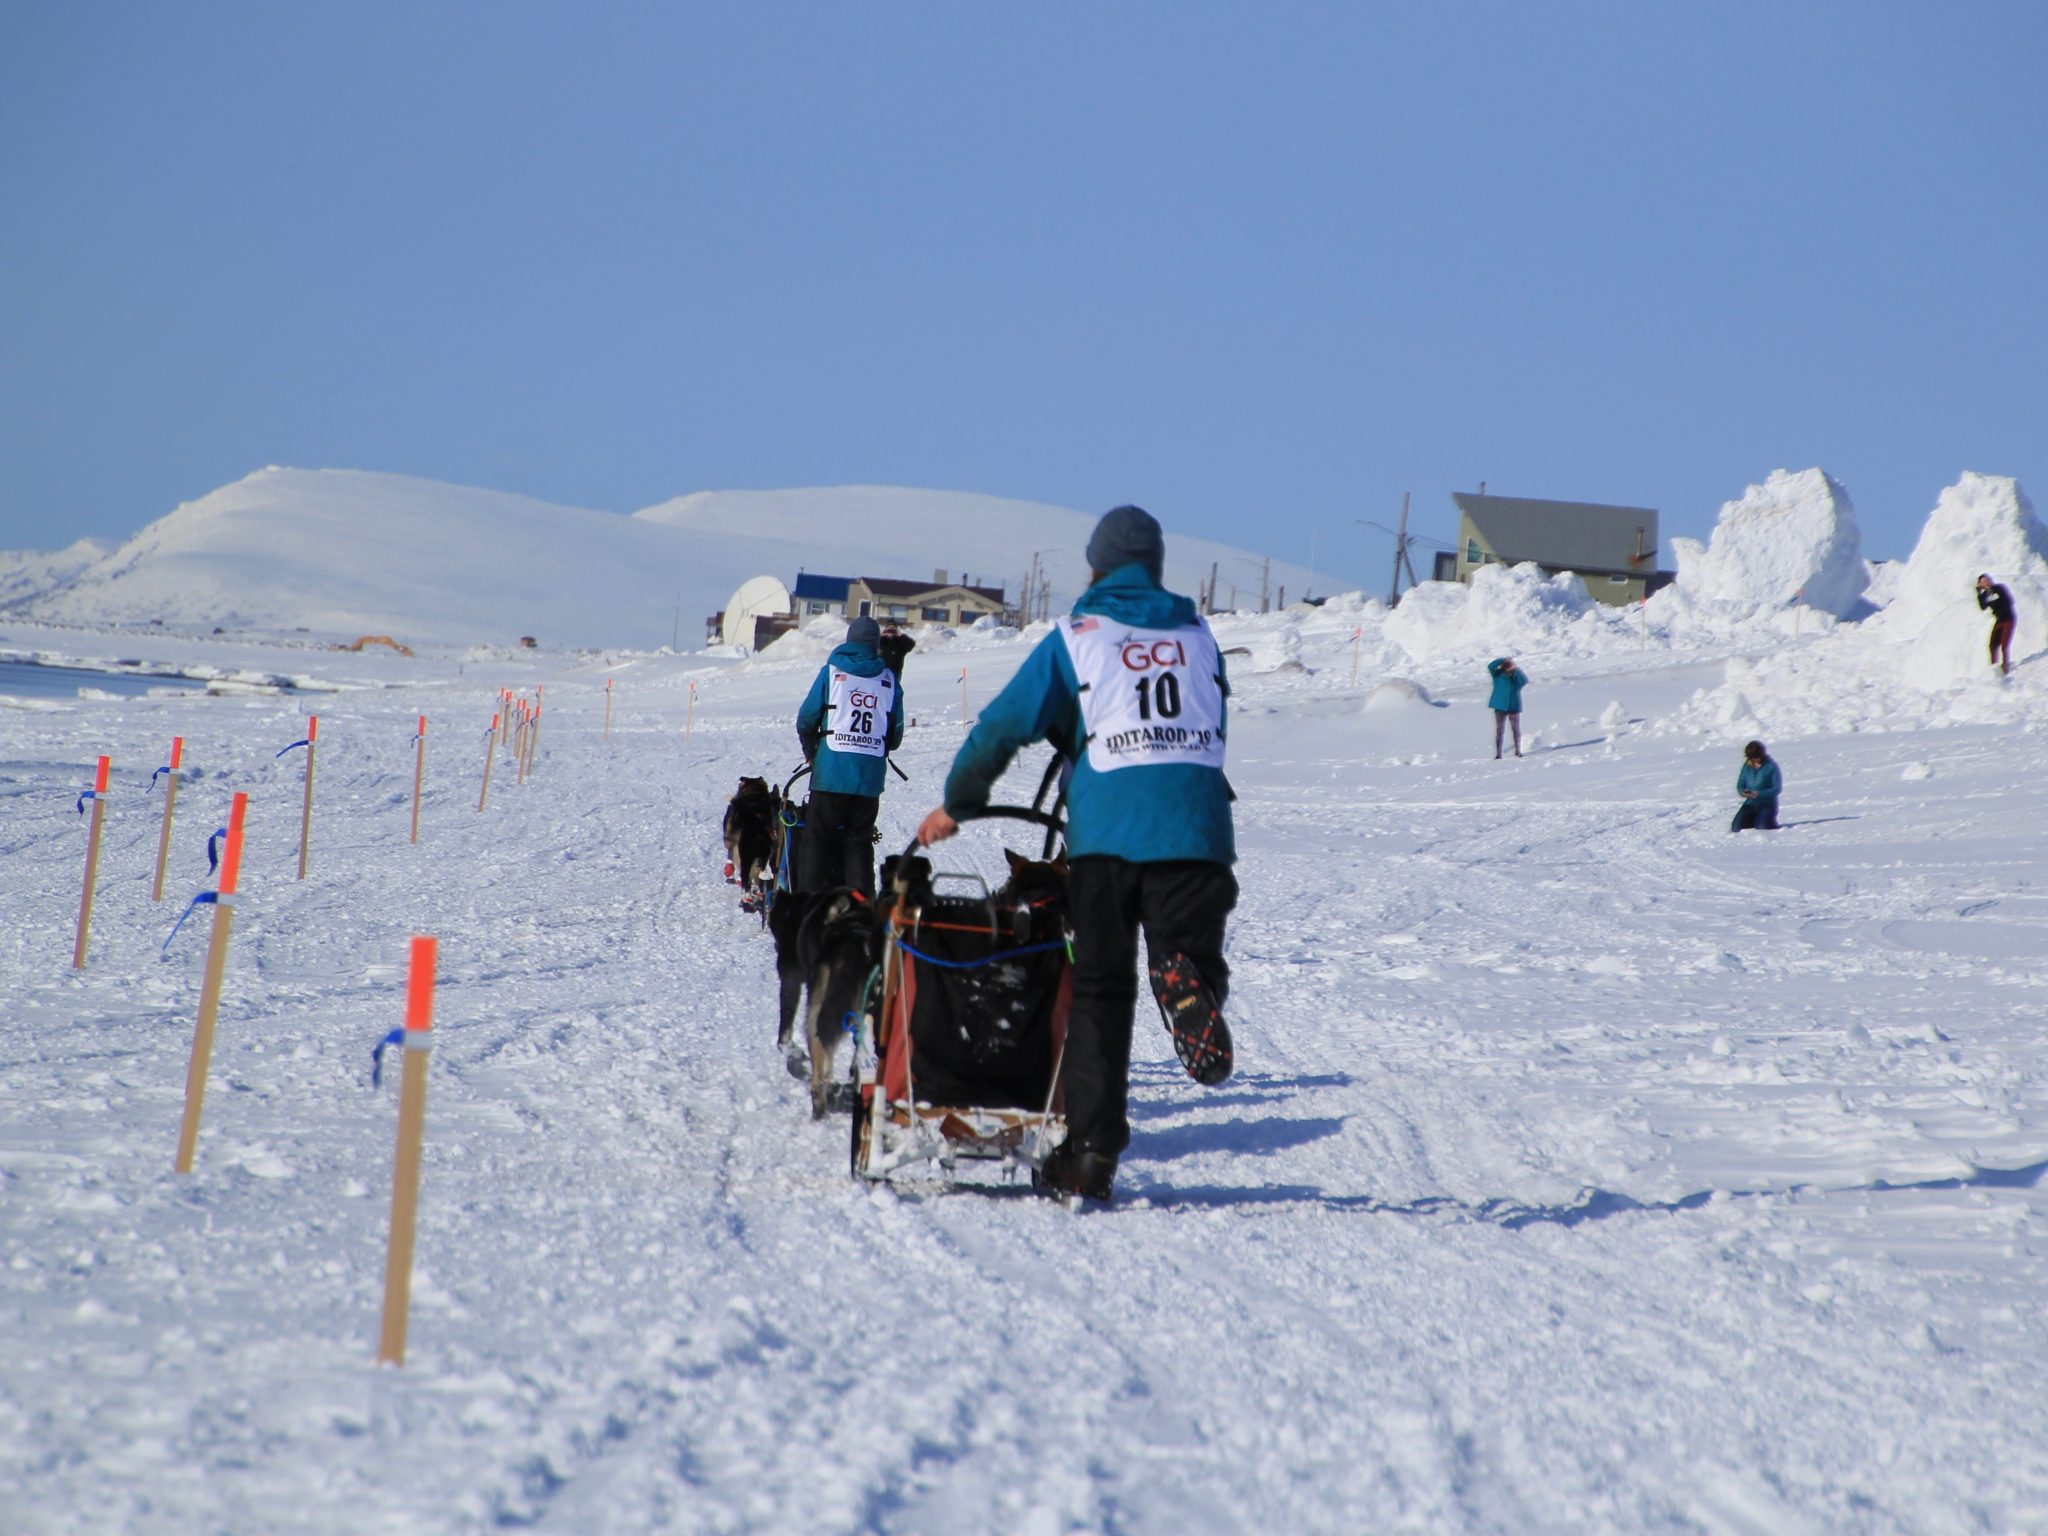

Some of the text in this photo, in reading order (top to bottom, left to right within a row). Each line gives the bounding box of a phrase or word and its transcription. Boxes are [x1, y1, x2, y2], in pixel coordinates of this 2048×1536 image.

[1122, 640, 1186, 672] GCI
[850, 693, 878, 710] GCI
[1135, 672, 1181, 720] 10
[849, 710, 873, 734] 26
[835, 733, 872, 744] IDITAROD
[1106, 726, 1187, 749] IDITAROD
